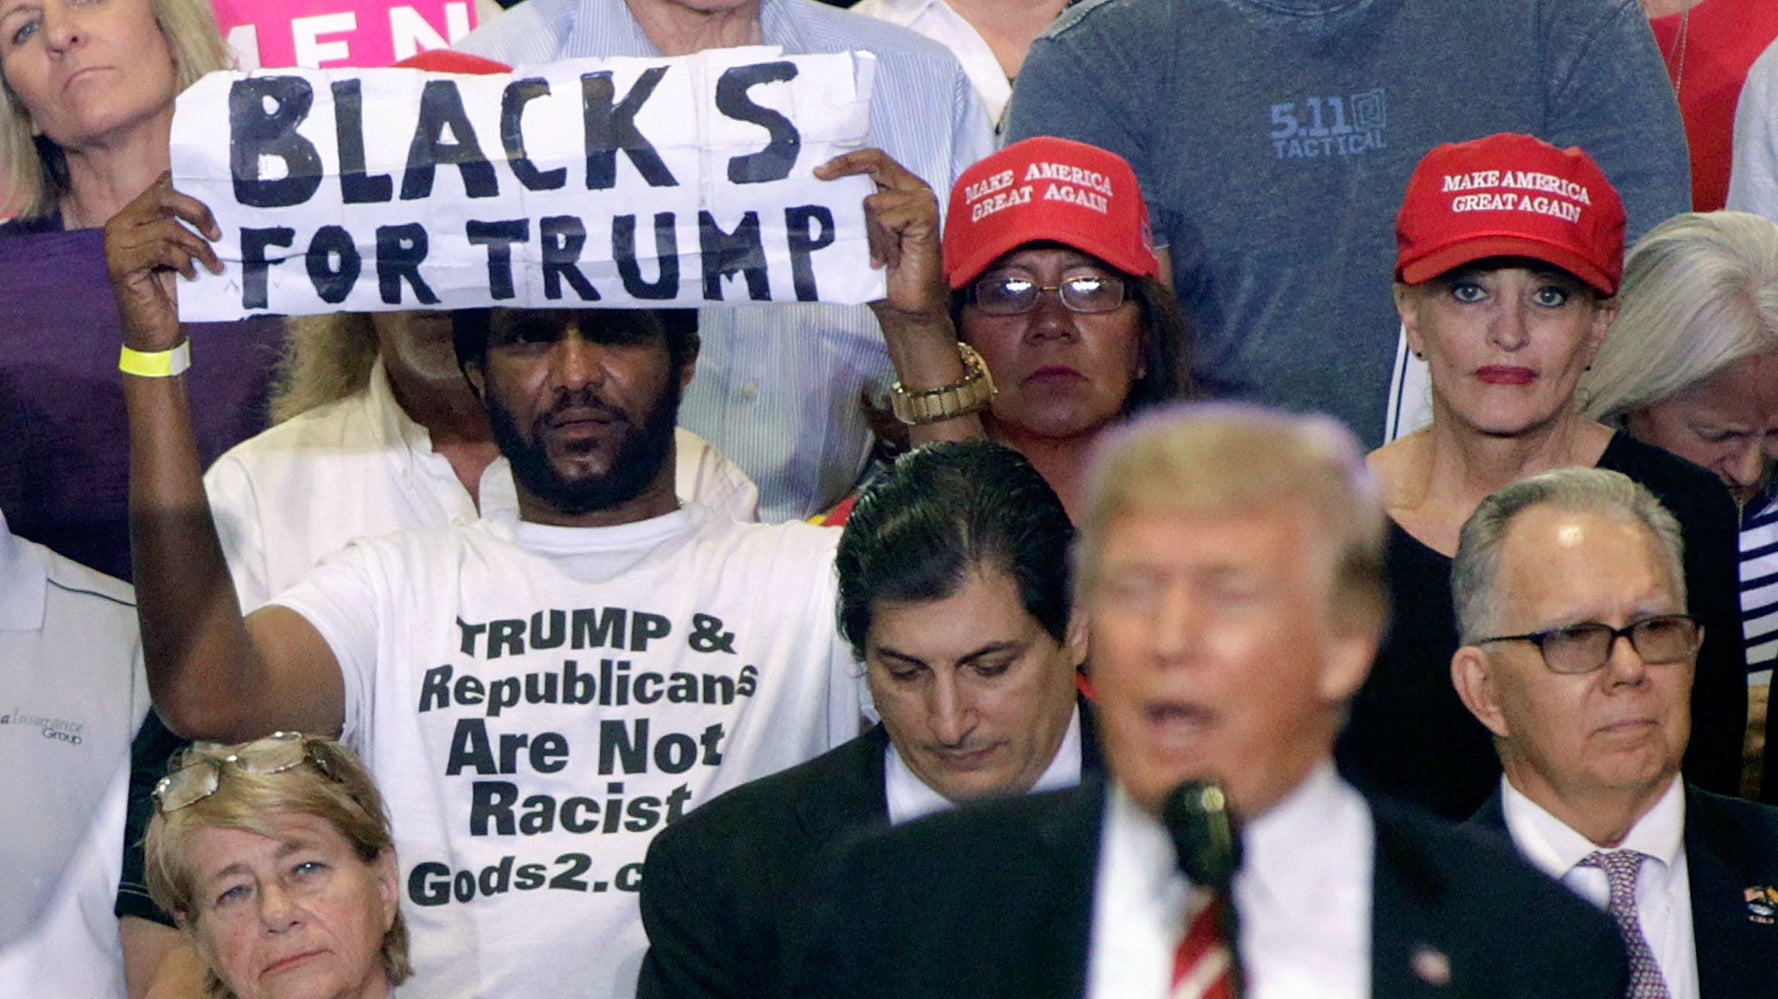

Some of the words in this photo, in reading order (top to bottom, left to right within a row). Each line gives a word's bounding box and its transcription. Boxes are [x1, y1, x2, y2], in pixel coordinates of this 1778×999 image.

[229, 62, 800, 208] BLACKS
[1270, 97, 1352, 139] 5.11
[1273, 130, 1386, 159] TACTICAL
[965, 170, 1014, 204] MAKE
[1025, 162, 1113, 196] AMERICA
[972, 186, 1033, 222] GREAT
[1044, 183, 1108, 214] AGAIN
[1442, 170, 1500, 192] MAKE
[1501, 171, 1591, 205] AMERICA
[1452, 194, 1518, 212] GREAT
[1518, 196, 1581, 224] AGAIN
[240, 222, 442, 311] FOR
[466, 203, 836, 304] TRUMP
[456, 607, 672, 660] TRUMP
[688, 613, 737, 654] &
[418, 659, 758, 717] Republicans
[42, 727, 82, 745] Group
[446, 718, 569, 776] Are
[597, 718, 725, 775] Not
[469, 781, 692, 836] Racist
